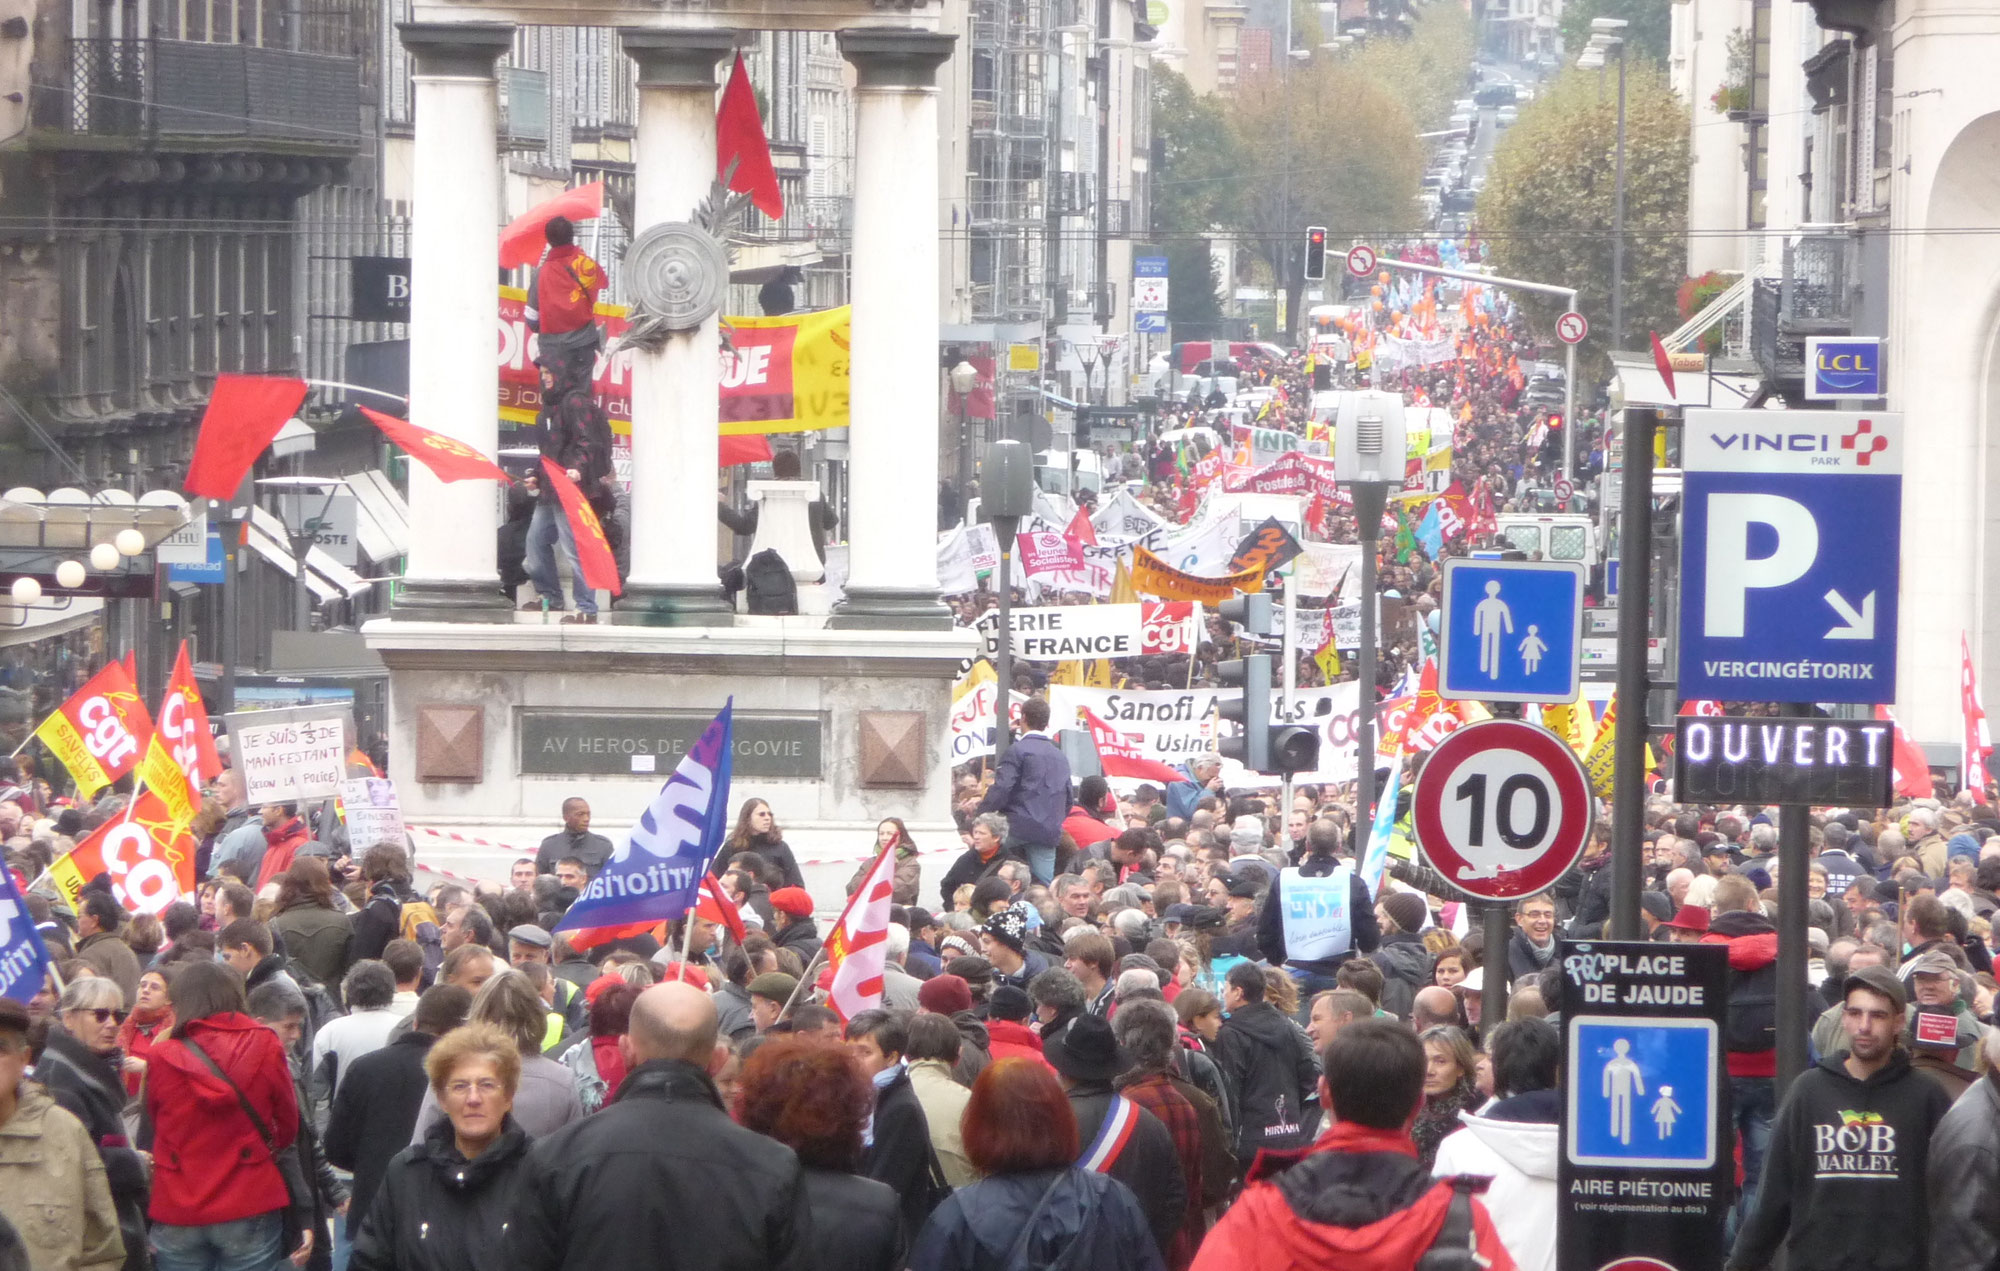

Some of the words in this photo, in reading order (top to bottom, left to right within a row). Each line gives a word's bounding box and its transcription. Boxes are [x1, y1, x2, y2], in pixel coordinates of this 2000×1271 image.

[719, 344, 772, 389] UE
[1671, 357, 1703, 368] Tabac
[1818, 354, 1870, 371] LCL
[1710, 433, 1828, 452] VINCI
[1811, 457, 1841, 466] PARK
[1029, 557, 1079, 569] Socialistes
[1703, 492, 1819, 638] P
[1141, 614, 1199, 652] cgt
[1024, 634, 1129, 655] FRANCE
[1704, 657, 1875, 681] VERCINGÉTORIX
[1103, 694, 1194, 722] Sanofi
[80, 695, 137, 768] cgt
[243, 734, 261, 749] JE
[319, 725, 340, 739] DE
[542, 737, 569, 753] AV
[578, 737, 649, 754] HEROS
[657, 738, 684, 755] DE
[730, 739, 803, 757] RGOVIE
[1685, 722, 1886, 766] OUVERT
[284, 777, 296, 788] LA
[1456, 773, 1551, 850] 10
[1604, 954, 1686, 976] PLACE
[1584, 983, 1616, 1003] DE
[1623, 984, 1705, 1006] JAUDE
[1812, 1123, 1897, 1154] BOB
[1570, 1179, 1615, 1196] AIRE
[1618, 1177, 1713, 1198] PIÉTONNE
[1671, 1205, 1683, 1214] au
